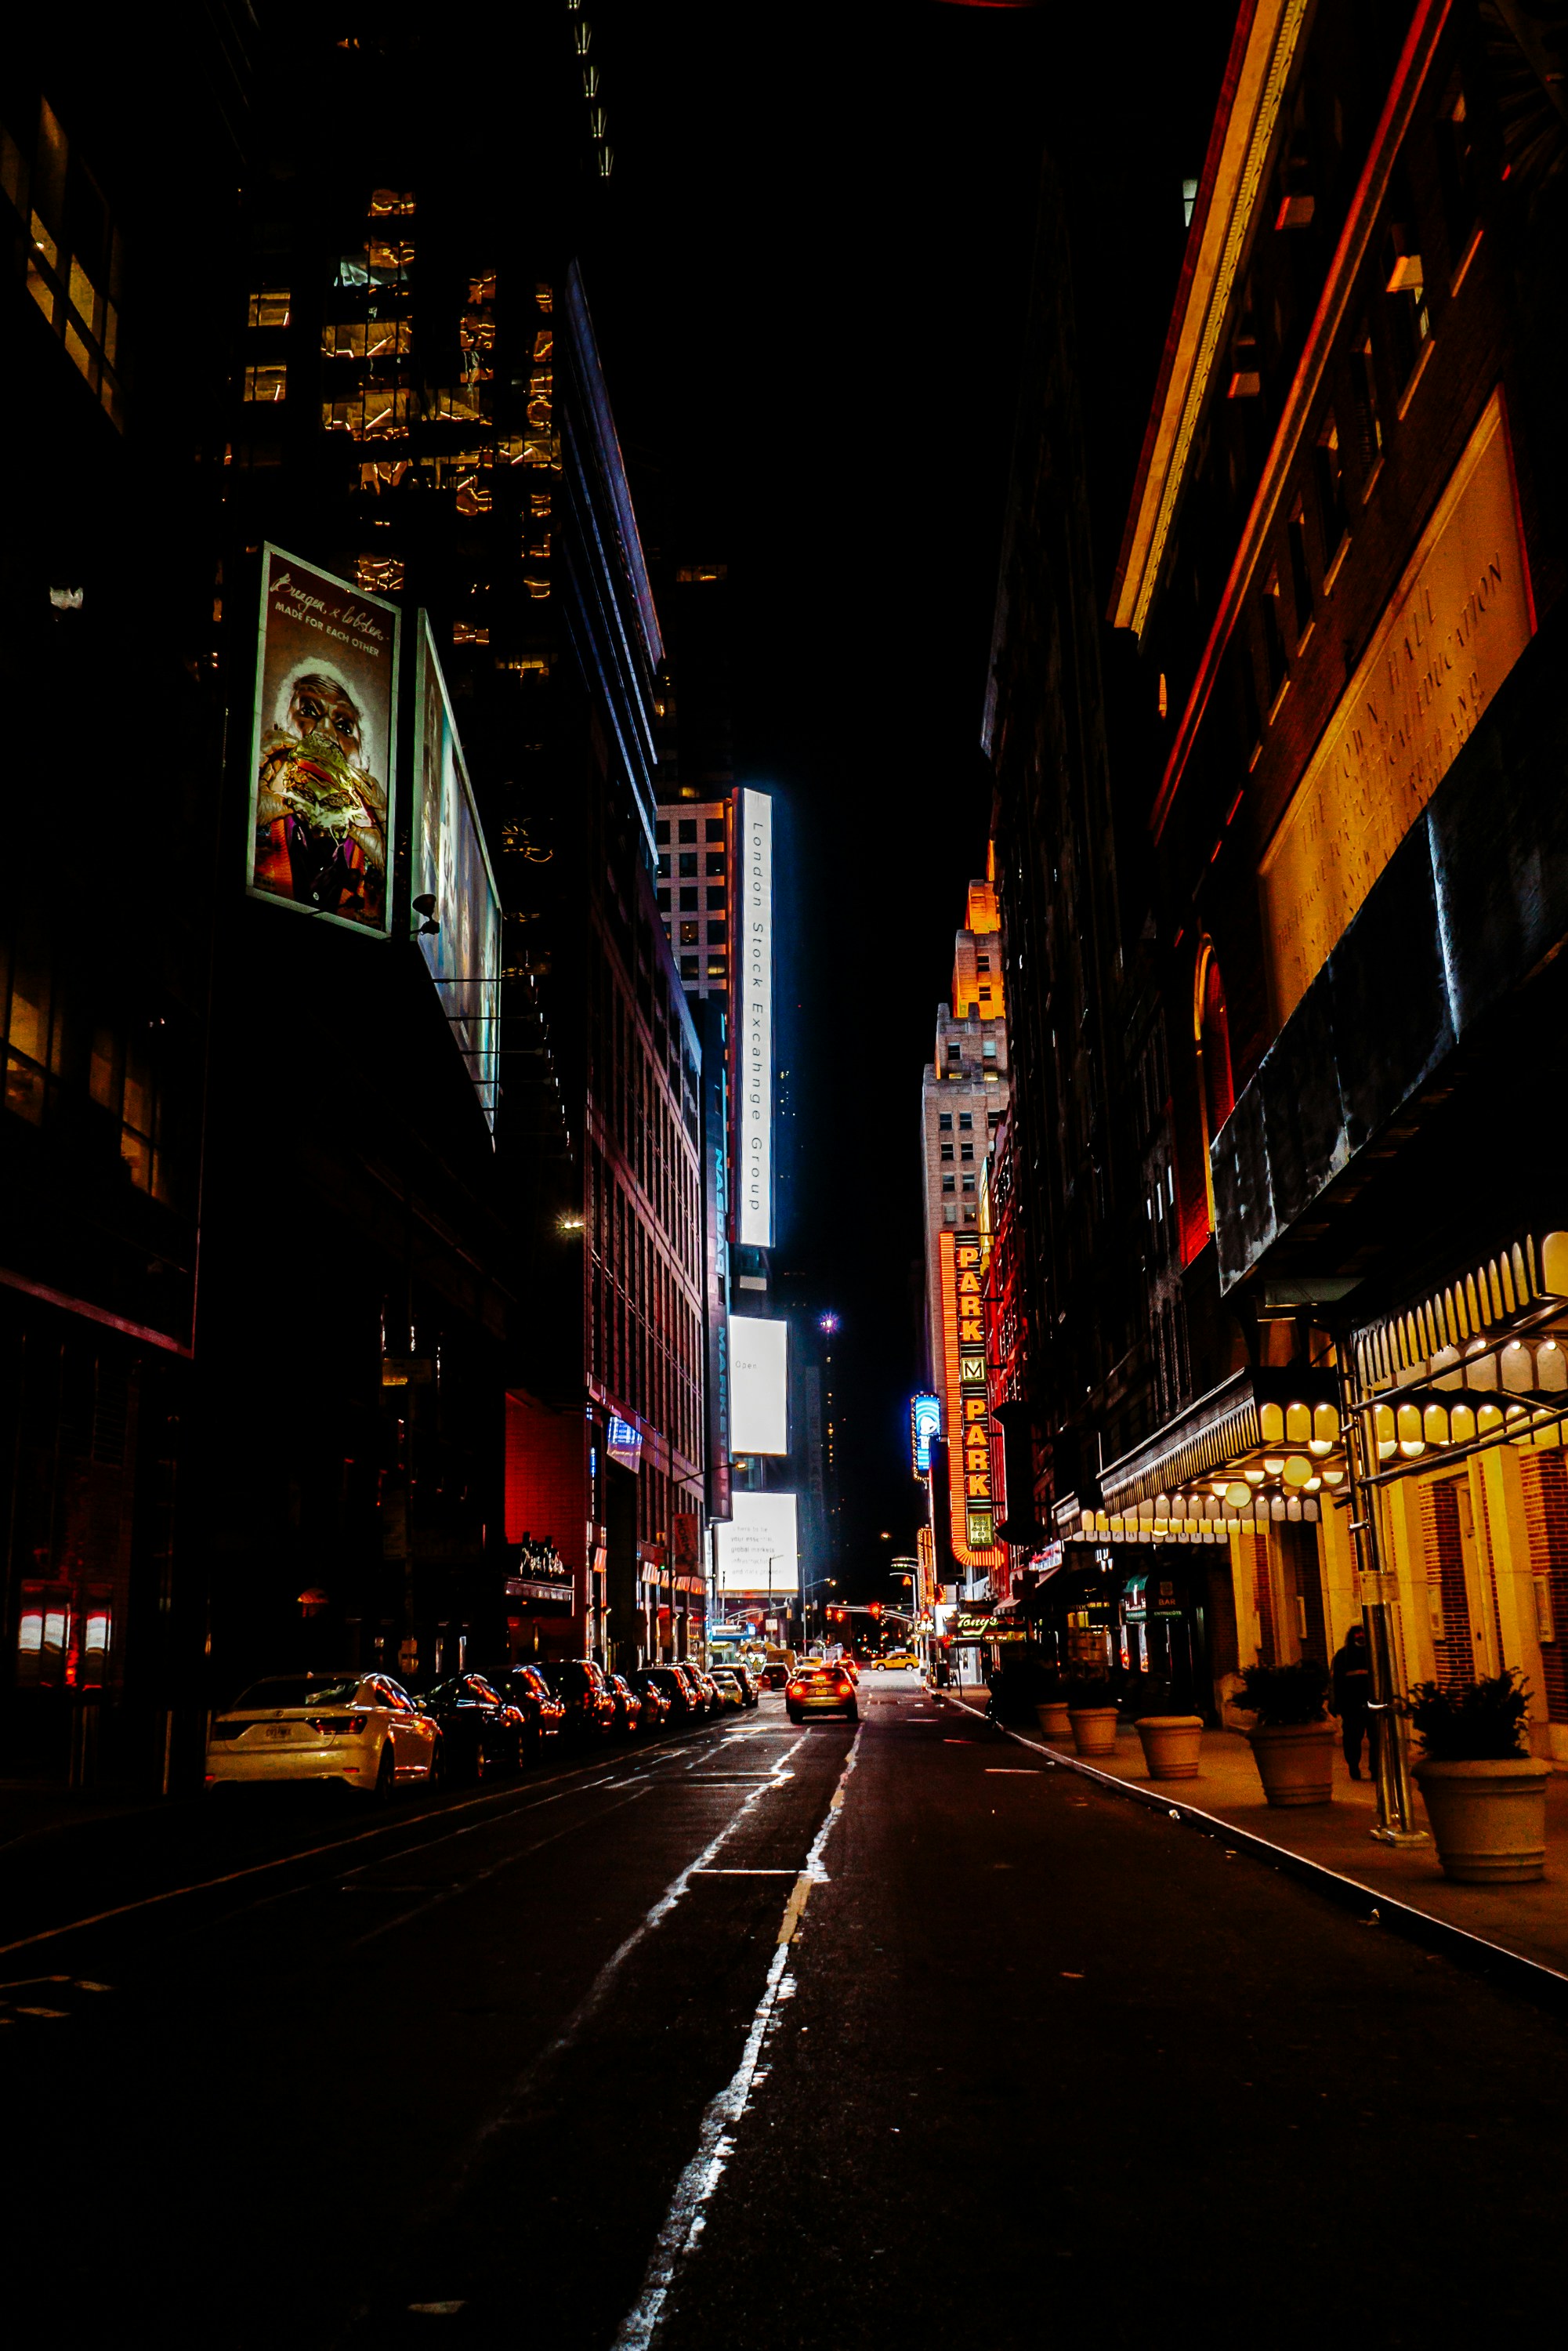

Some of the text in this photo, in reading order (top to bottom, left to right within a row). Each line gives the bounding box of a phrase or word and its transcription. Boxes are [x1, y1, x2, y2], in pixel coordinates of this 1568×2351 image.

[274, 601, 380, 657] MADE FOR EACH OTHER
[1387, 585, 1438, 694] HALL
[1417, 550, 1502, 718] EDUCATION
[750, 822, 763, 1210] London Stock Excahnge Group
[715, 1147, 725, 1274] NASDAQ
[959, 1247, 983, 1342] PARK
[735, 1360, 758, 1370] Open
[965, 1400, 990, 1496] PARK
[957, 1613, 999, 1637] Tony's
